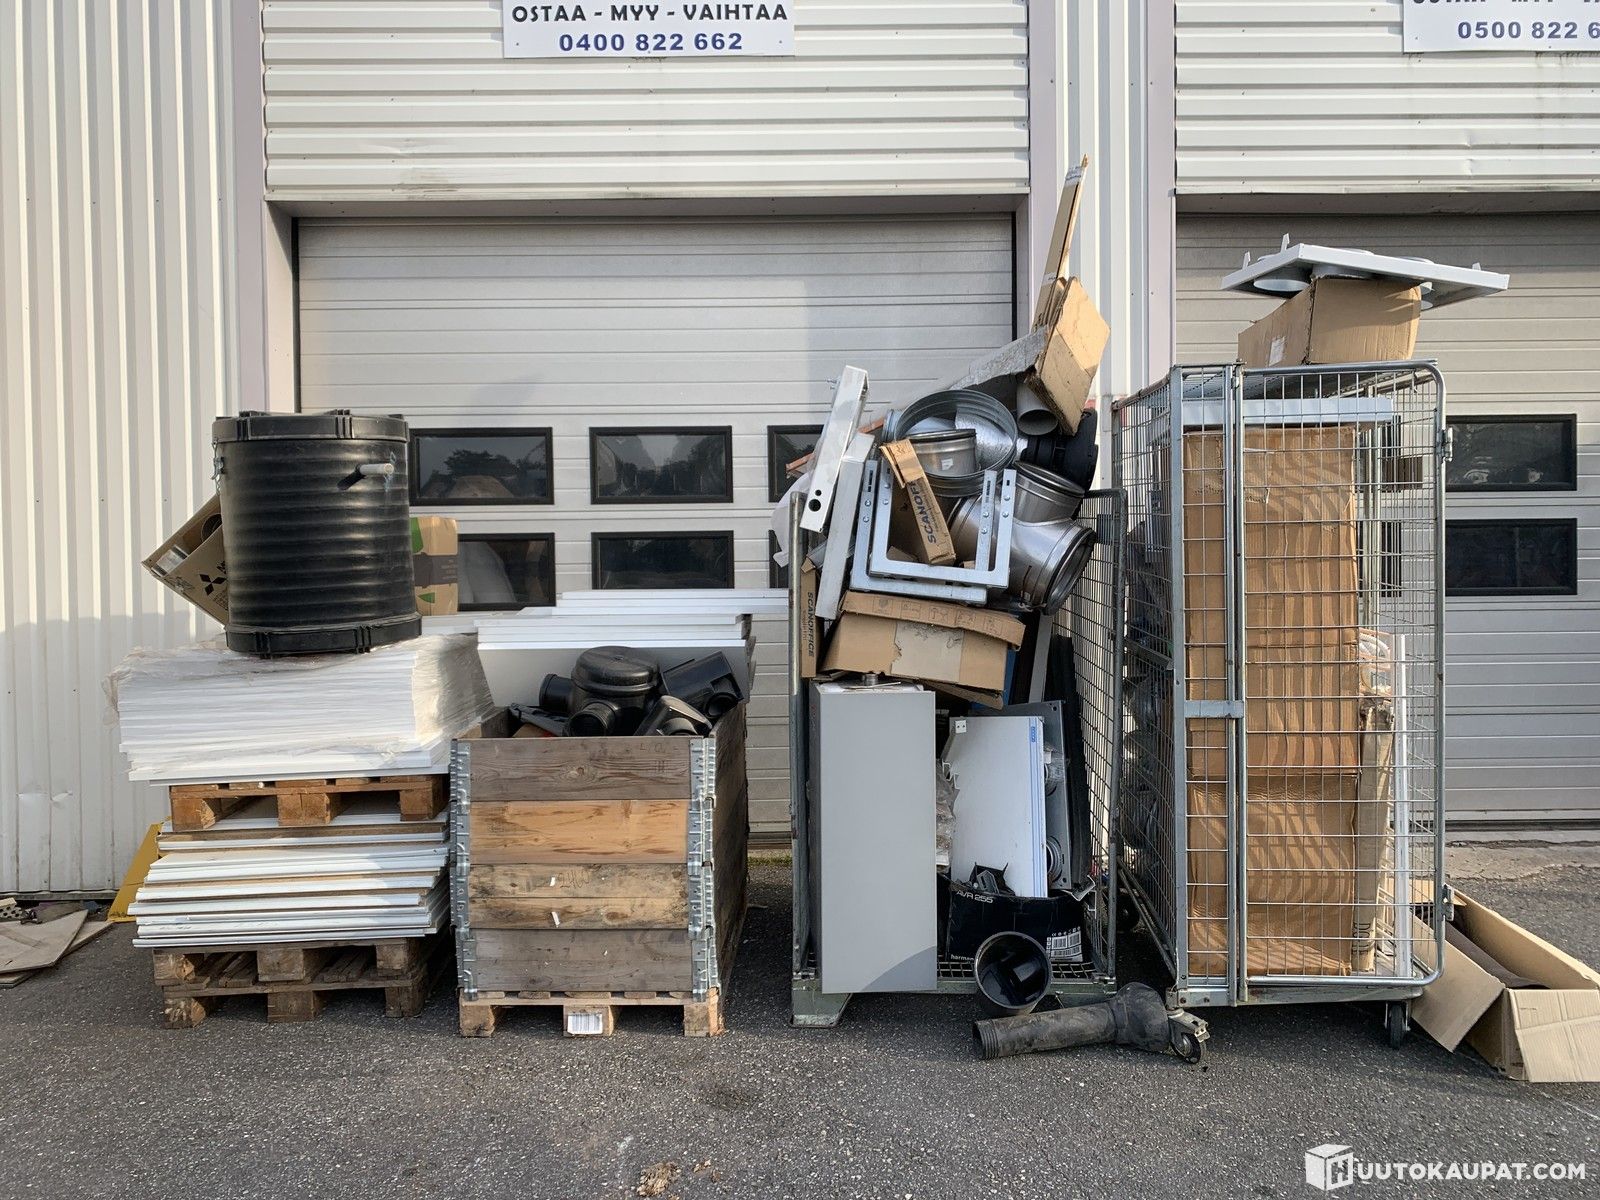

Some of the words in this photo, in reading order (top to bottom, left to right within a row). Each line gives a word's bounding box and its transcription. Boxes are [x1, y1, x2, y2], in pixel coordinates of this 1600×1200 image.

[511, 4, 587, 22] OSTAA
[610, 4, 659, 21] MYY
[683, 3, 788, 21] VAIHTAA
[1457, 21, 1521, 39] 0500
[1531, 21, 1578, 39] 822
[559, 33, 625, 52] 0400
[635, 33, 684, 51] 822
[694, 32, 743, 51] 662
[807, 591, 815, 658] SCANOFFICE
